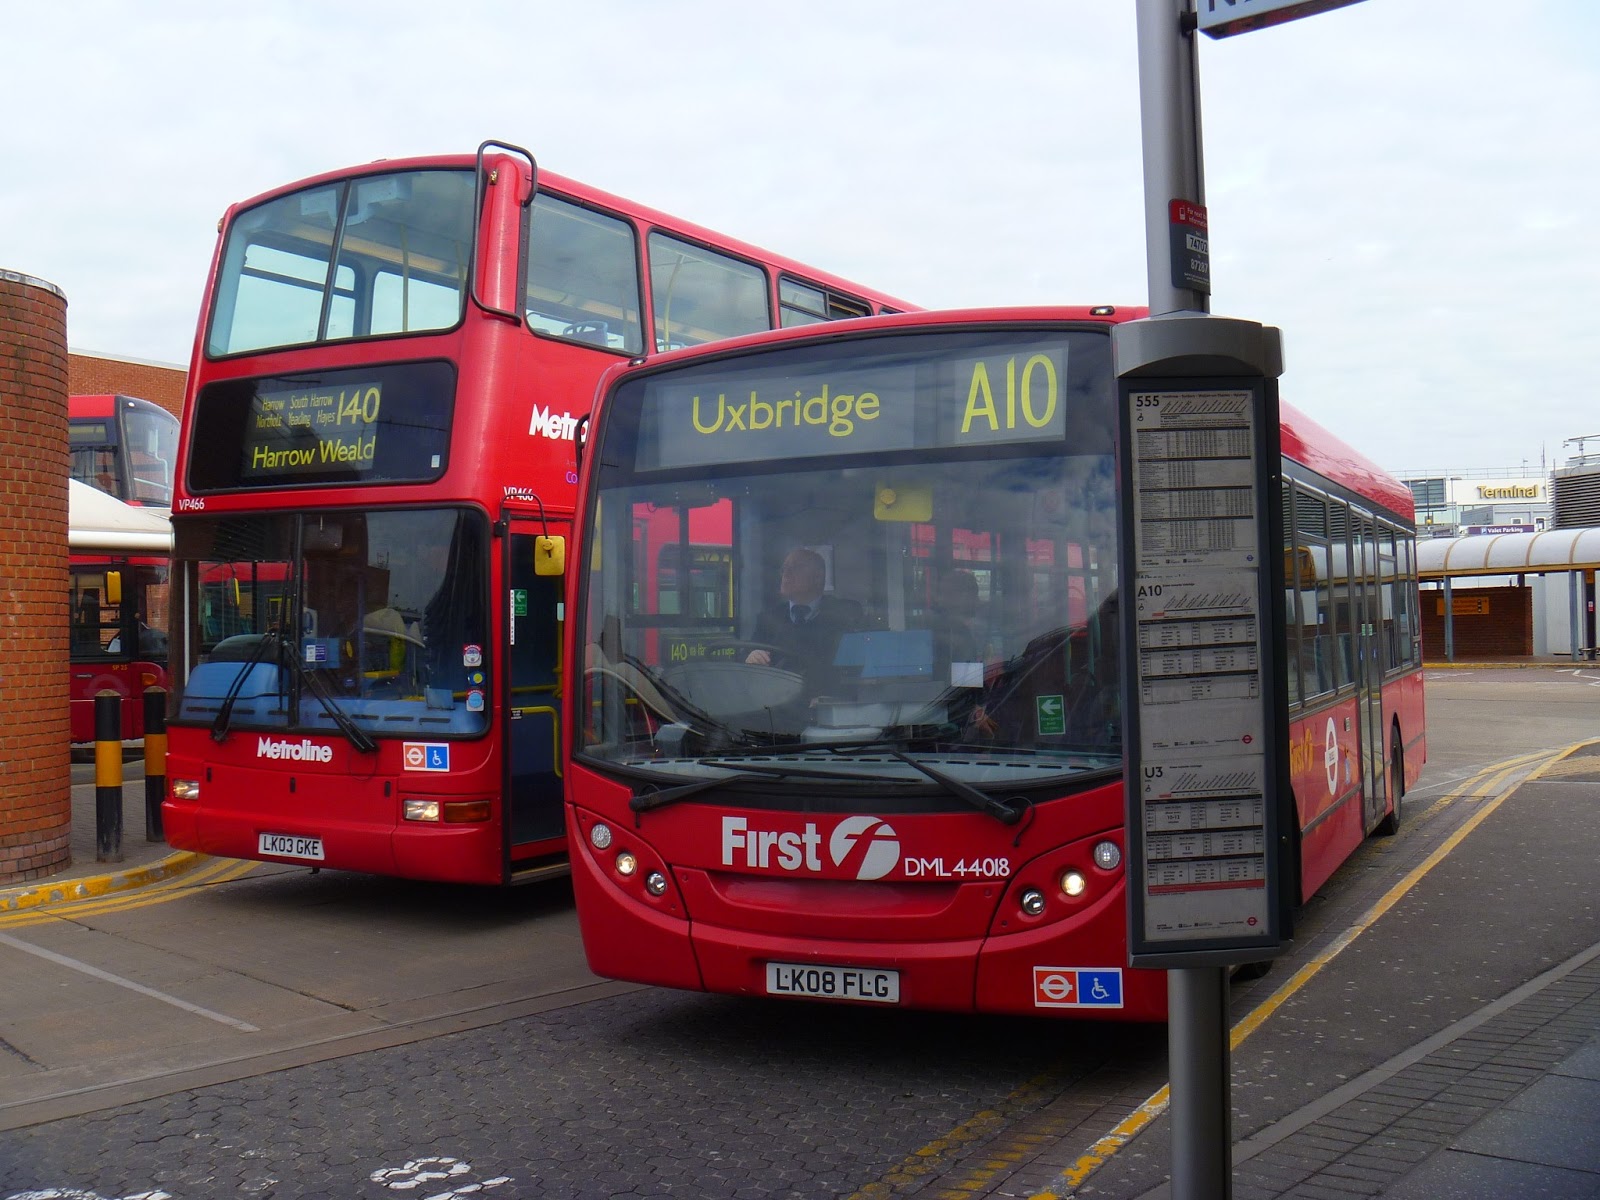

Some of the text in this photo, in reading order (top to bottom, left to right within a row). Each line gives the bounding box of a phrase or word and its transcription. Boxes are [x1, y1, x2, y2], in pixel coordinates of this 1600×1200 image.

[692, 353, 1058, 437] Uxbridge A10
[1136, 395, 1160, 407] 555
[262, 386, 380, 426] Harrow South Harrow 140
[287, 411, 312, 428] Yeading
[316, 409, 336, 427] Hayes
[252, 435, 376, 469] Harrow Weald
[503, 486, 534, 501] VP466
[1477, 484, 1539, 499] Terminal
[178, 497, 205, 511] VP466
[1502, 526, 1524, 534] Parking
[1137, 584, 1162, 597] A10
[671, 643, 688, 661] 140
[257, 736, 333, 763] Metroline
[1144, 766, 1164, 779] U3
[263, 835, 320, 856] LK03 GKE
[721, 816, 822, 872] First
[904, 857, 1011, 878] DML44018
[775, 967, 889, 998] LK08 FLG
